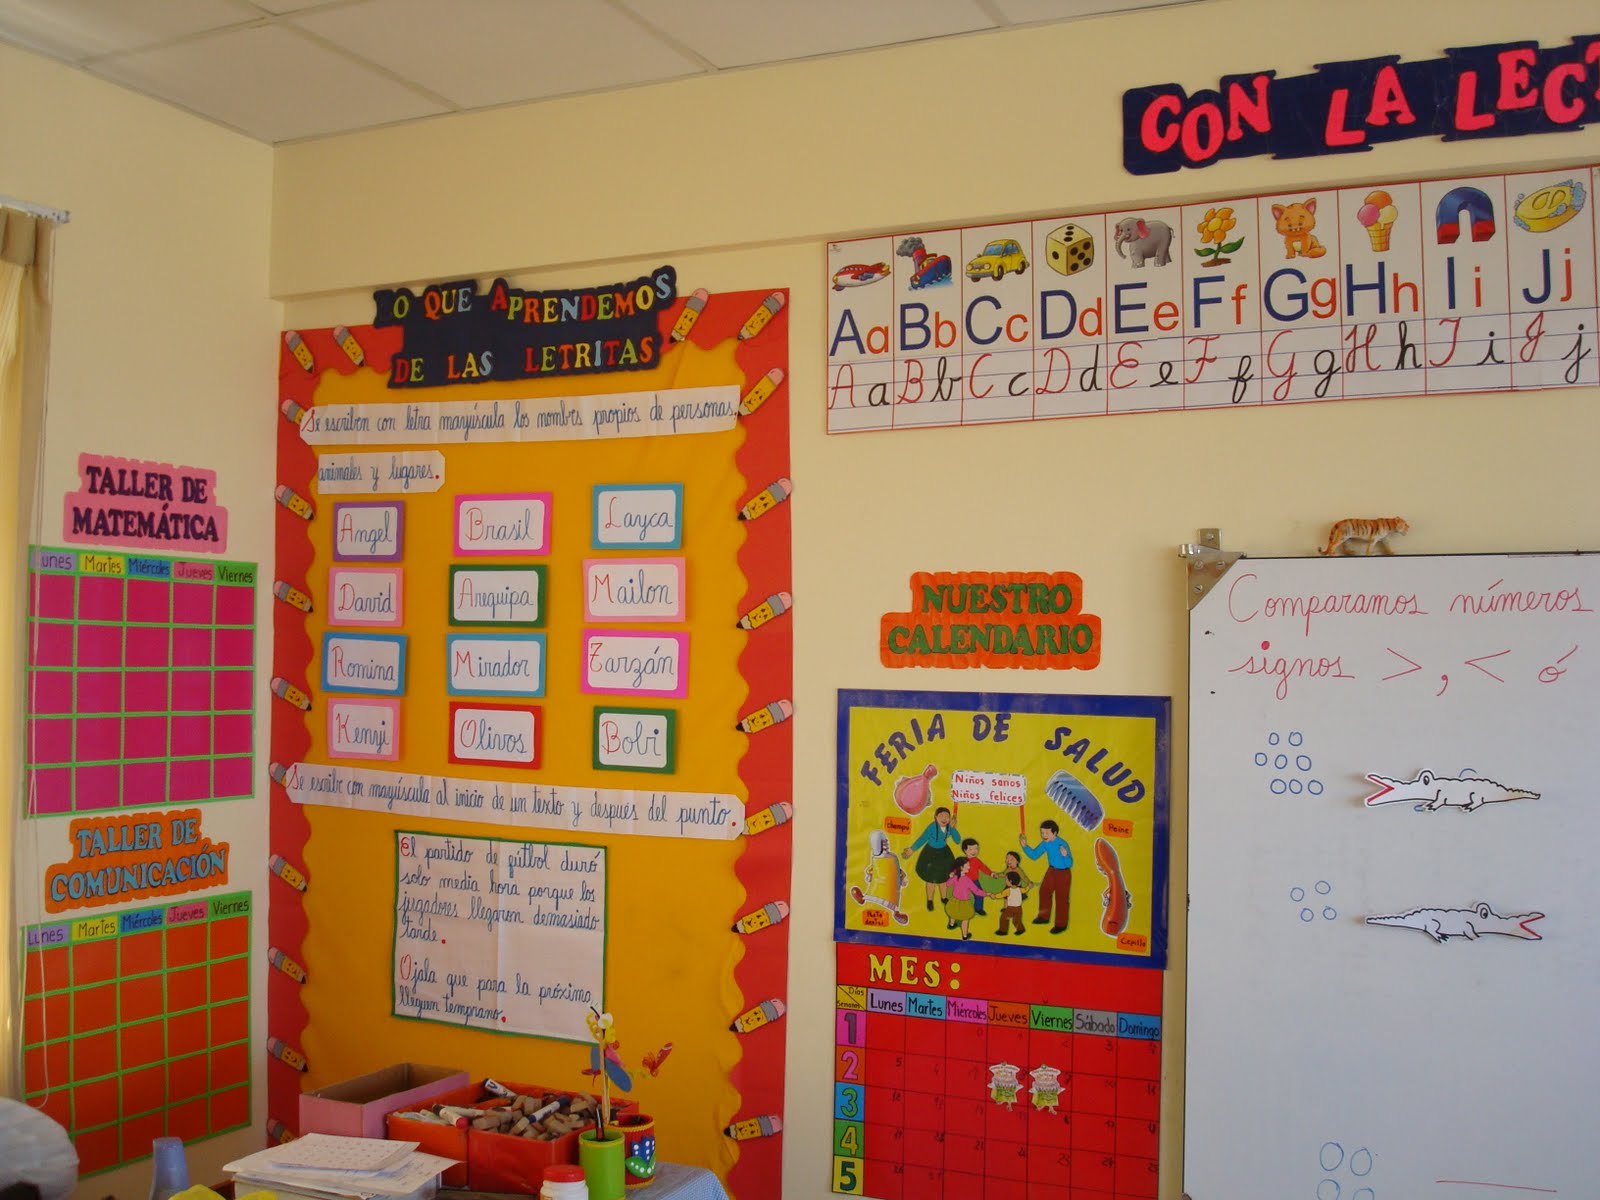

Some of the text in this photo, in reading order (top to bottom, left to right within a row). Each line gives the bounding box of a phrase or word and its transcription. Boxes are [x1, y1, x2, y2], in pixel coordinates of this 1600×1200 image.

[1140, 75, 1271, 161] CON
[1324, 65, 1416, 146] LA
[424, 287, 472, 320] QUE
[490, 273, 671, 323] APRENDEMOS
[394, 336, 654, 383] DE LAS LETRITAS
[377, 416, 396, 431] con
[405, 405, 432, 431] letra
[513, 400, 530, 428] los
[592, 403, 641, 434] propios
[650, 394, 663, 420] de
[86, 465, 208, 503] TALLER DE
[318, 456, 440, 491] animales y lugares.
[72, 502, 219, 542] MATEMÁTICA
[339, 510, 393, 553] Angel
[465, 507, 534, 541] Brasil
[604, 496, 673, 541] Layca
[40, 554, 72, 570] unes
[84, 555, 122, 574] Martes
[178, 561, 213, 580] Jueves
[218, 566, 253, 583] Viernes
[592, 569, 673, 605] Mailon
[338, 582, 394, 613] David
[458, 577, 534, 619] Arequipa
[921, 583, 1072, 614] NUESTRO
[1228, 573, 1593, 637] Comparamos números
[887, 623, 1093, 656] CALENDARIO
[332, 645, 396, 682] Romina
[453, 649, 530, 678] Mirador
[589, 642, 674, 688] Zarzán
[1228, 640, 1355, 700] signos
[335, 713, 390, 754] Kenyi
[459, 719, 527, 753] Olivos
[601, 720, 661, 756] Bobi
[860, 712, 1146, 803] FERIA DE SALUD
[952, 789, 1023, 802] Niños felices
[955, 774, 1021, 788] Niños sanos
[286, 765, 304, 790] Se
[347, 778, 363, 796] con
[368, 776, 430, 810] mayúscula
[436, 779, 449, 805] al
[454, 788, 485, 808] inicio
[492, 784, 505, 810] de
[510, 794, 527, 812] un
[532, 786, 565, 815] texto
[571, 800, 582, 827] y
[590, 791, 639, 827] después
[648, 794, 667, 822] del
[676, 797, 737, 835] punto.
[76, 818, 198, 858] TALLER DE
[1108, 823, 1129, 834] Peine
[51, 844, 226, 902] COMUNICACIÓN
[400, 836, 416, 858] El
[424, 840, 473, 869] partido
[486, 840, 498, 865] de
[560, 851, 600, 873] duró
[400, 865, 595, 911] solo media hora porque los
[78, 919, 116, 937] Martes
[169, 906, 204, 922] Jueves
[213, 900, 249, 915] Viernes
[398, 891, 599, 932] jugadores llegaron demasiado
[400, 954, 437, 993] Ojala
[447, 972, 468, 997] que
[477, 977, 507, 1000] para
[515, 972, 531, 996] la
[868, 953, 961, 990] MES:
[844, 1012, 857, 1044] 1
[870, 993, 1159, 1039] Lunes Martes Miércoles Jueves Viernes Sábado Domingo
[841, 1050, 858, 1080] 2
[840, 1087, 858, 1117] 3
[840, 1126, 858, 1155] 4
[840, 1160, 857, 1191] 5
